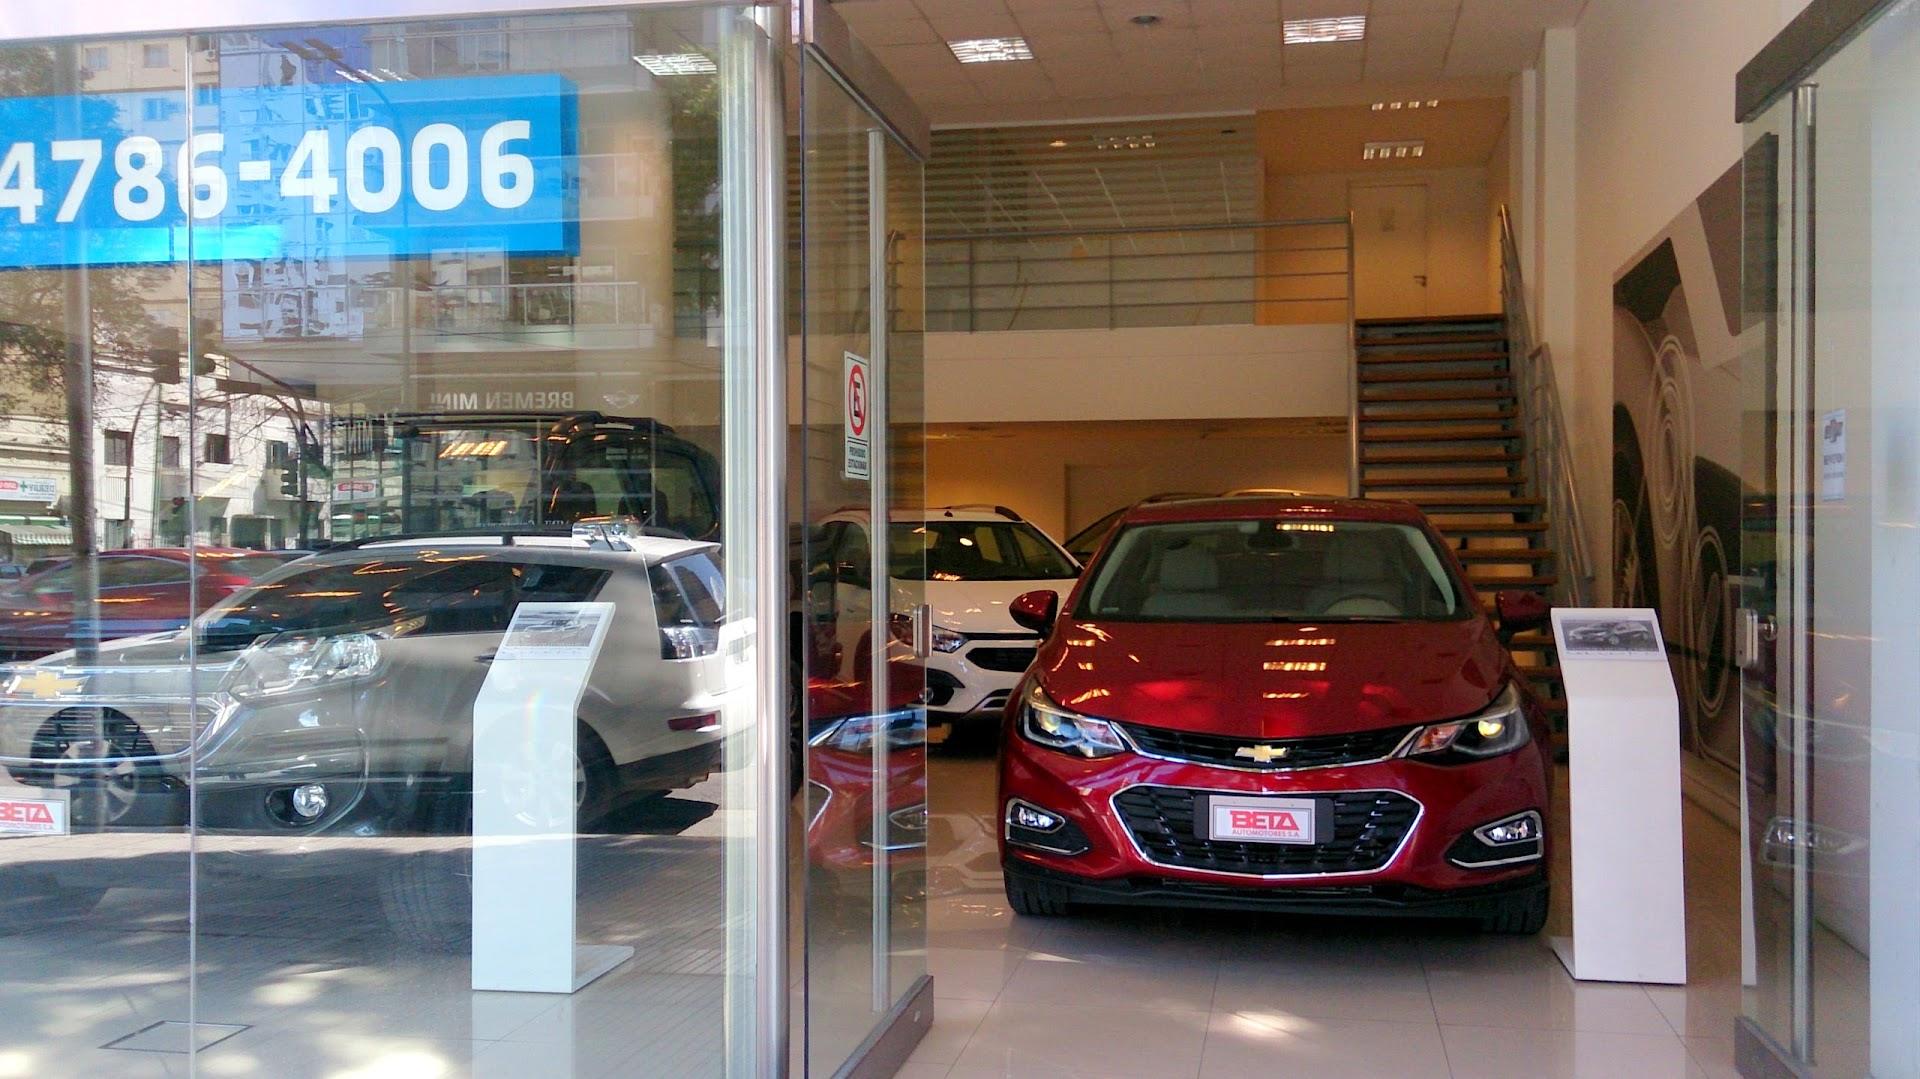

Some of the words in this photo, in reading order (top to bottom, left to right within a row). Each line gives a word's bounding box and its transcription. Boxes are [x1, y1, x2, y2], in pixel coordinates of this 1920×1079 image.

[0, 120, 534, 225] 4786-4006
[1230, 810, 1299, 831] BETA
[1232, 828, 1286, 837] AUTOMOTORES
